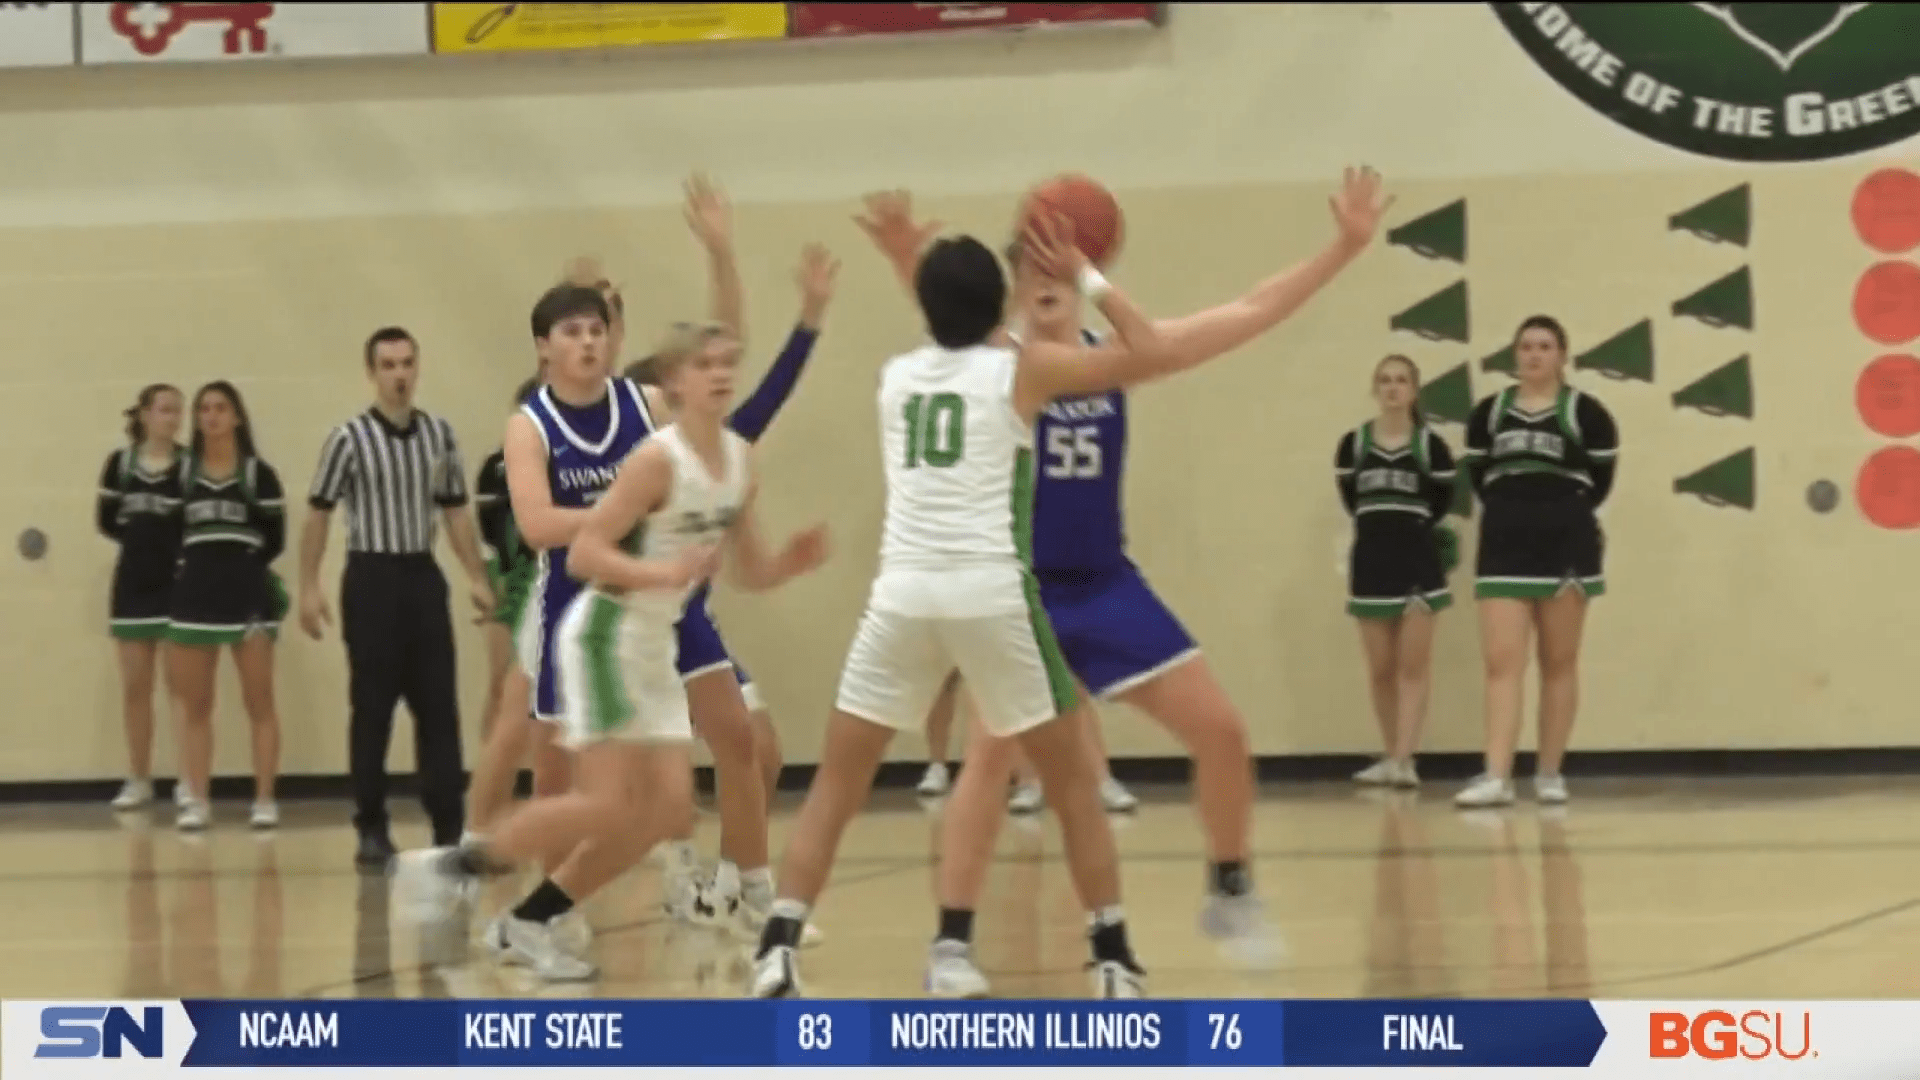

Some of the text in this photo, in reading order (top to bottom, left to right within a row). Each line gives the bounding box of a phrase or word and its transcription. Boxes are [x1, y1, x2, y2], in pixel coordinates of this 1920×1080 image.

[1521, 3, 1624, 88] OME
[1623, 72, 1684, 114] OF
[1692, 96, 1775, 138] THE
[904, 393, 964, 468] 10
[1044, 426, 1103, 479] 55
